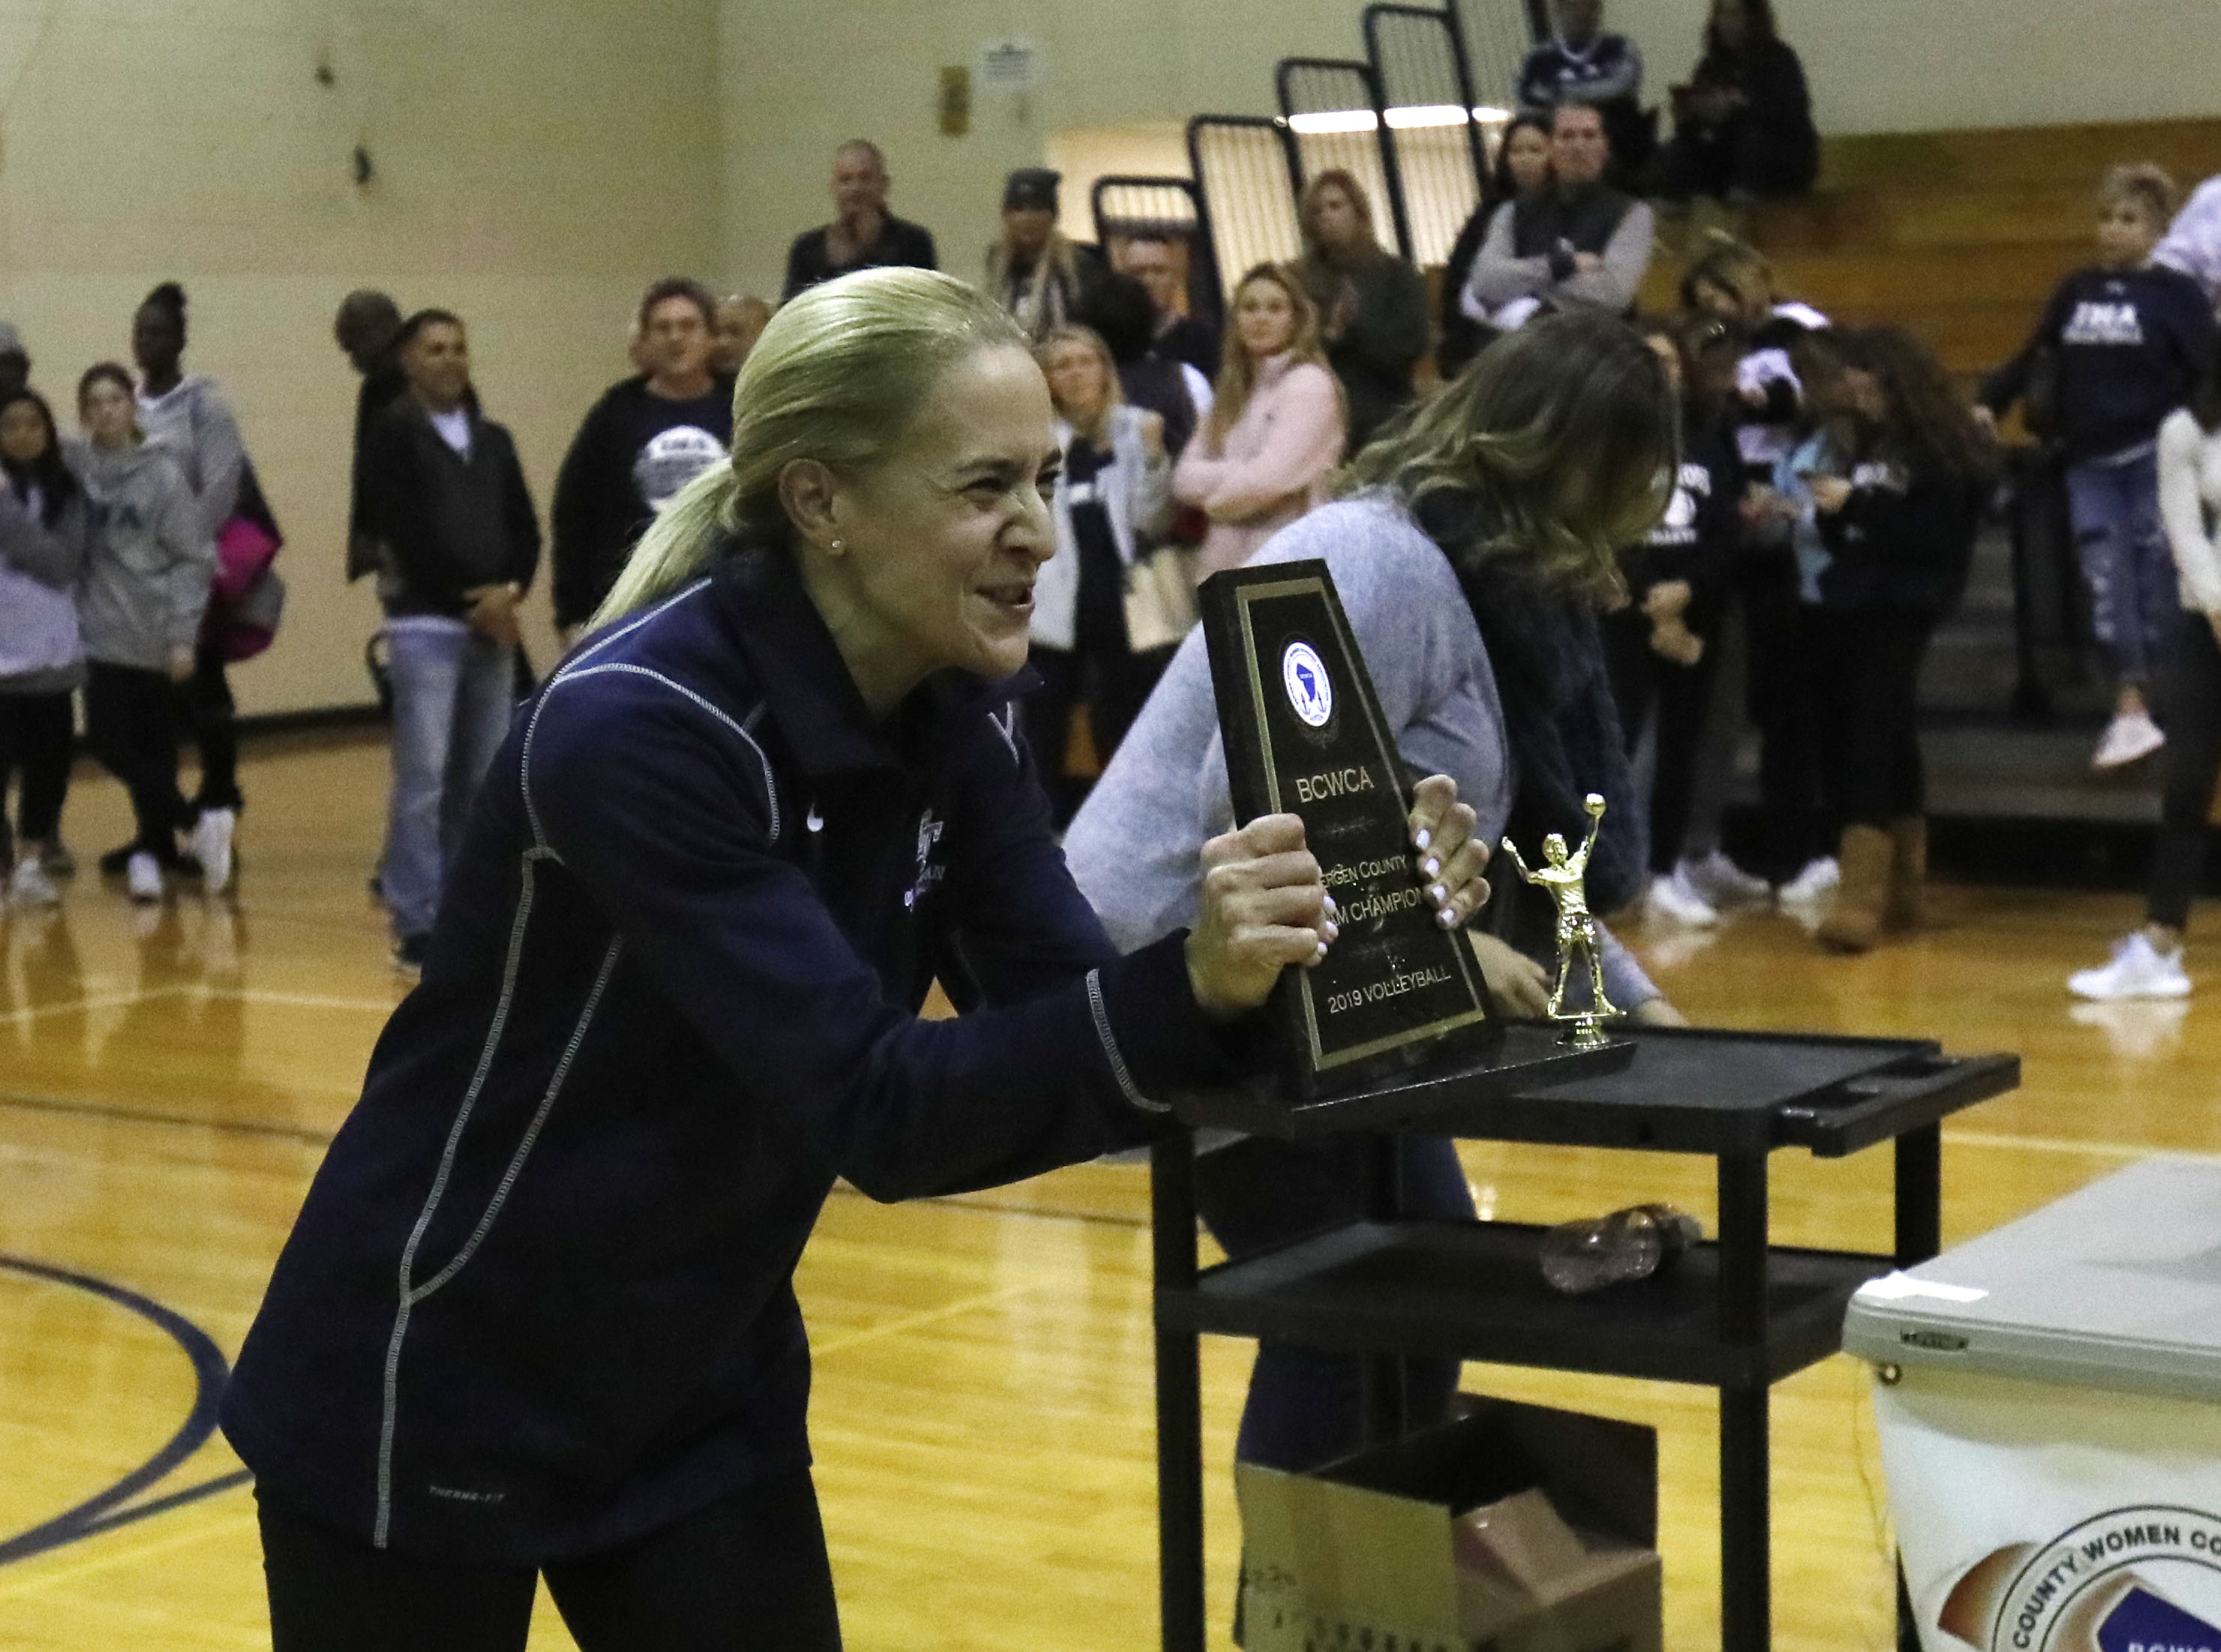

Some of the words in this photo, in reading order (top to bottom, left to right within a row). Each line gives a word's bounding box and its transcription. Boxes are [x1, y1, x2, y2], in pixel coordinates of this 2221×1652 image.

[1295, 765, 1375, 803] BCWCA
[1320, 867, 1359, 888] ERGEN
[1359, 854, 1407, 879] COUNTY
[1327, 989, 1363, 1014] 2019
[1363, 965, 1452, 1002] VOLLEYBALL
[2012, 1553, 2078, 1649] COUNTY
[2081, 1524, 2180, 1561] WOMEN
